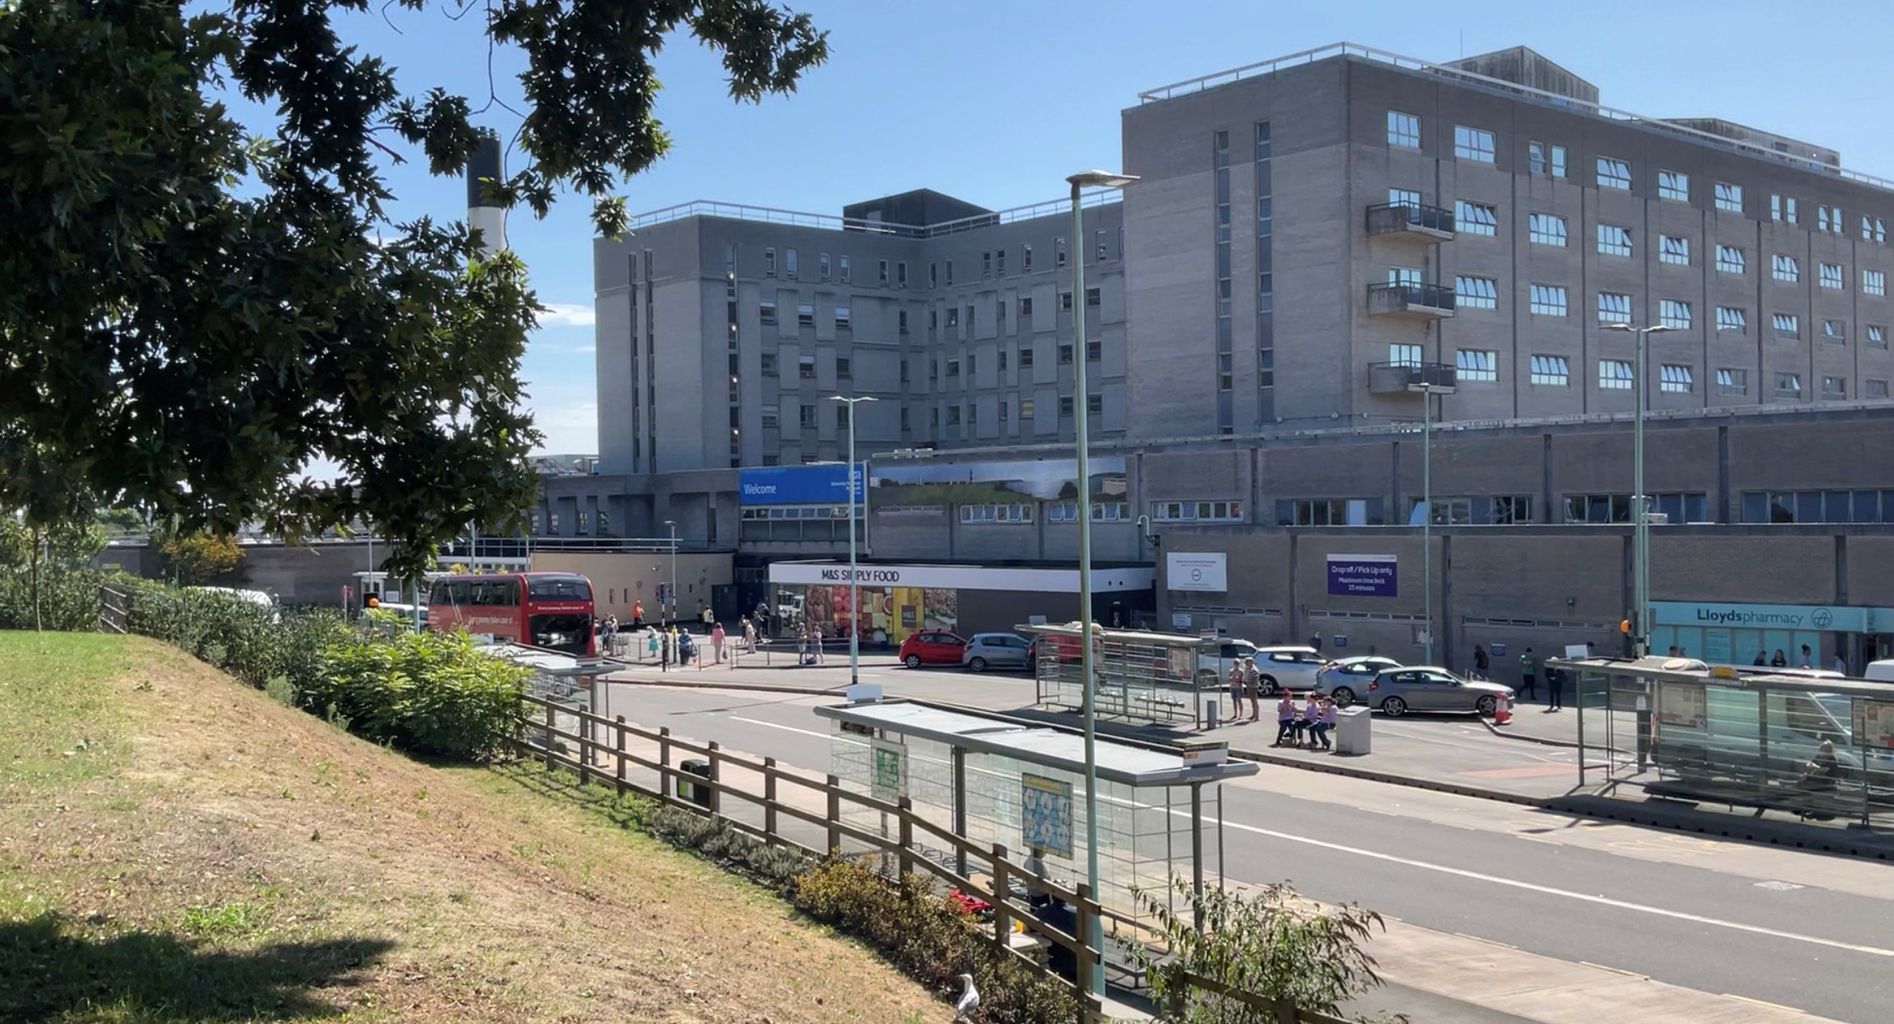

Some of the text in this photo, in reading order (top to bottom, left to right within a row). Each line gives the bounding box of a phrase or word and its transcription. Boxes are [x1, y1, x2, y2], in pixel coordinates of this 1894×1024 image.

[743, 484, 776, 495] Welcome
[821, 570, 839, 580] M&S
[873, 571, 899, 582] FOOD
[1331, 566, 1345, 575] Drop
[1697, 609, 1803, 626] Lloydspharmacy
